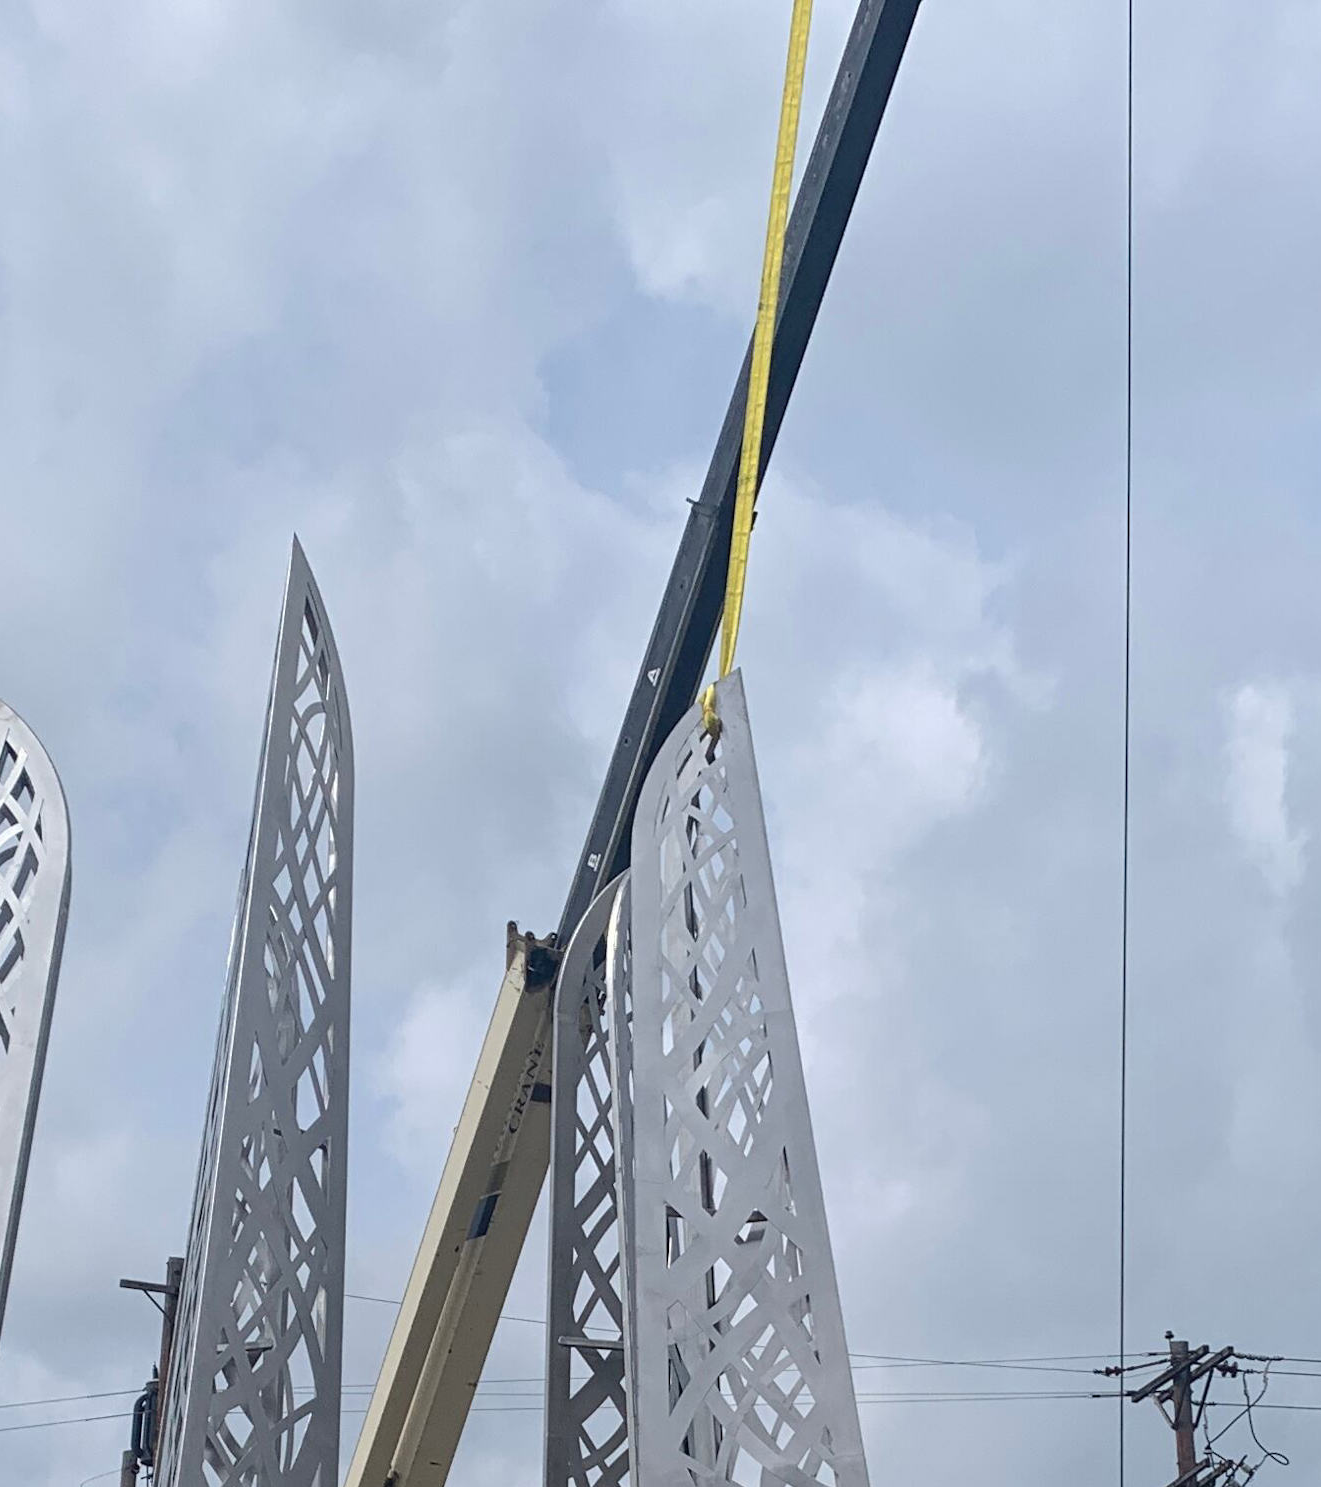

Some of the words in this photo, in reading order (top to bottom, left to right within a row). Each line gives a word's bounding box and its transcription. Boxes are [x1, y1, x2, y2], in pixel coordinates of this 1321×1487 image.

[647, 668, 661, 686] A
[587, 853, 601, 872] B
[508, 1040, 545, 1134] CRANE
